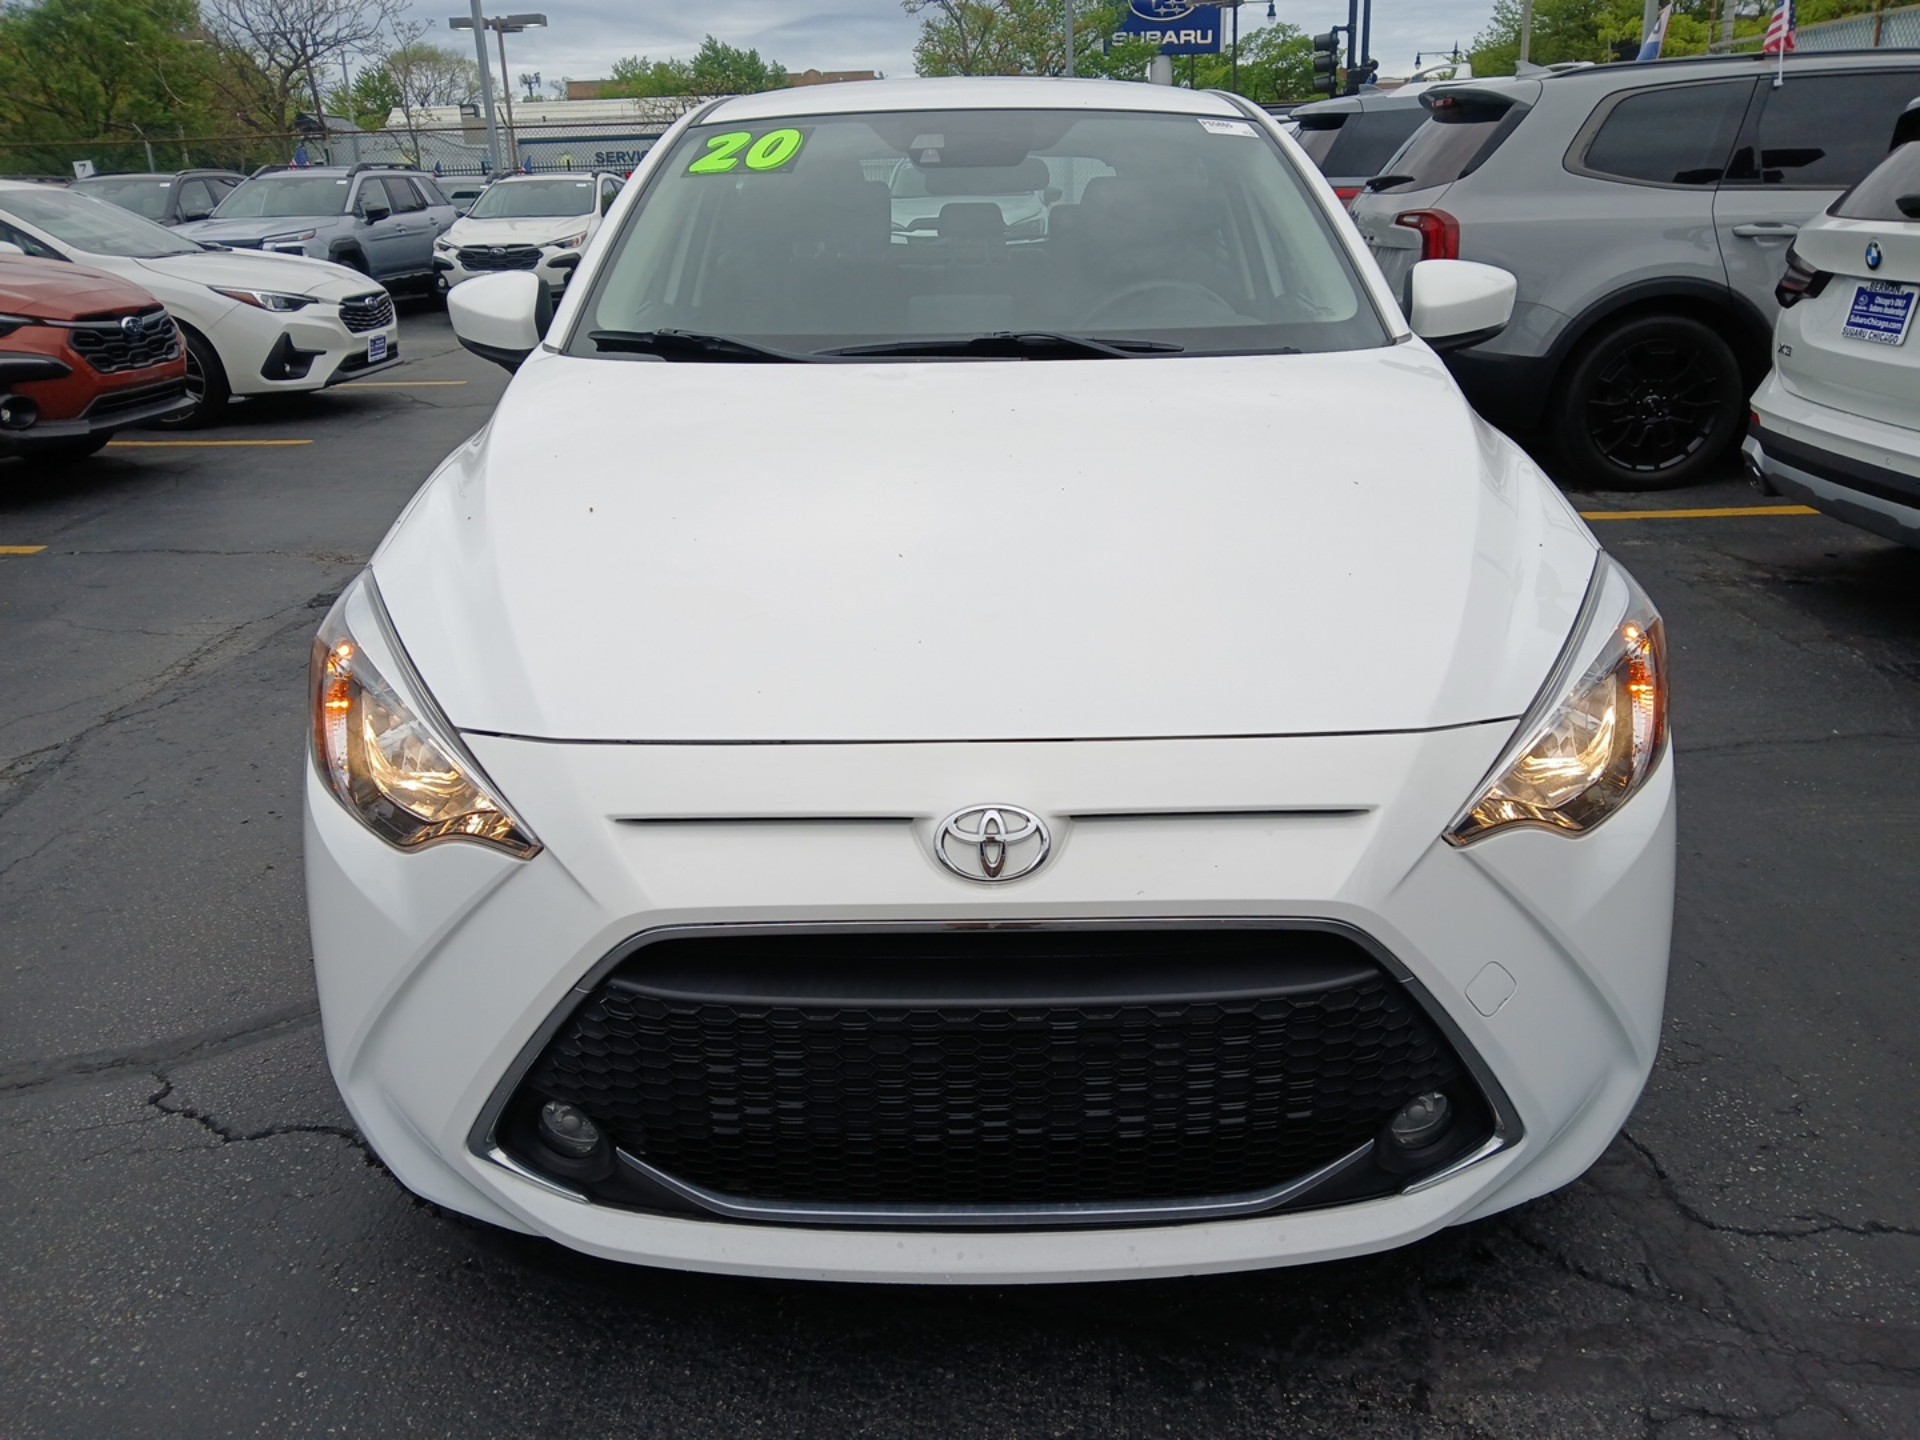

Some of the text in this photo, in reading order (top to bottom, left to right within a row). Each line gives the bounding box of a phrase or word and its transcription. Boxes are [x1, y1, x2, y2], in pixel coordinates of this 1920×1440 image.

[1111, 29, 1213, 46] SUBARU
[688, 128, 804, 173] 20
[78, 163, 86, 174] 7
[1849, 315, 1902, 329] SubaruChicago.com
[1842, 327, 1900, 345] SUBARU CHICAGO
[1777, 343, 1793, 358] X3
